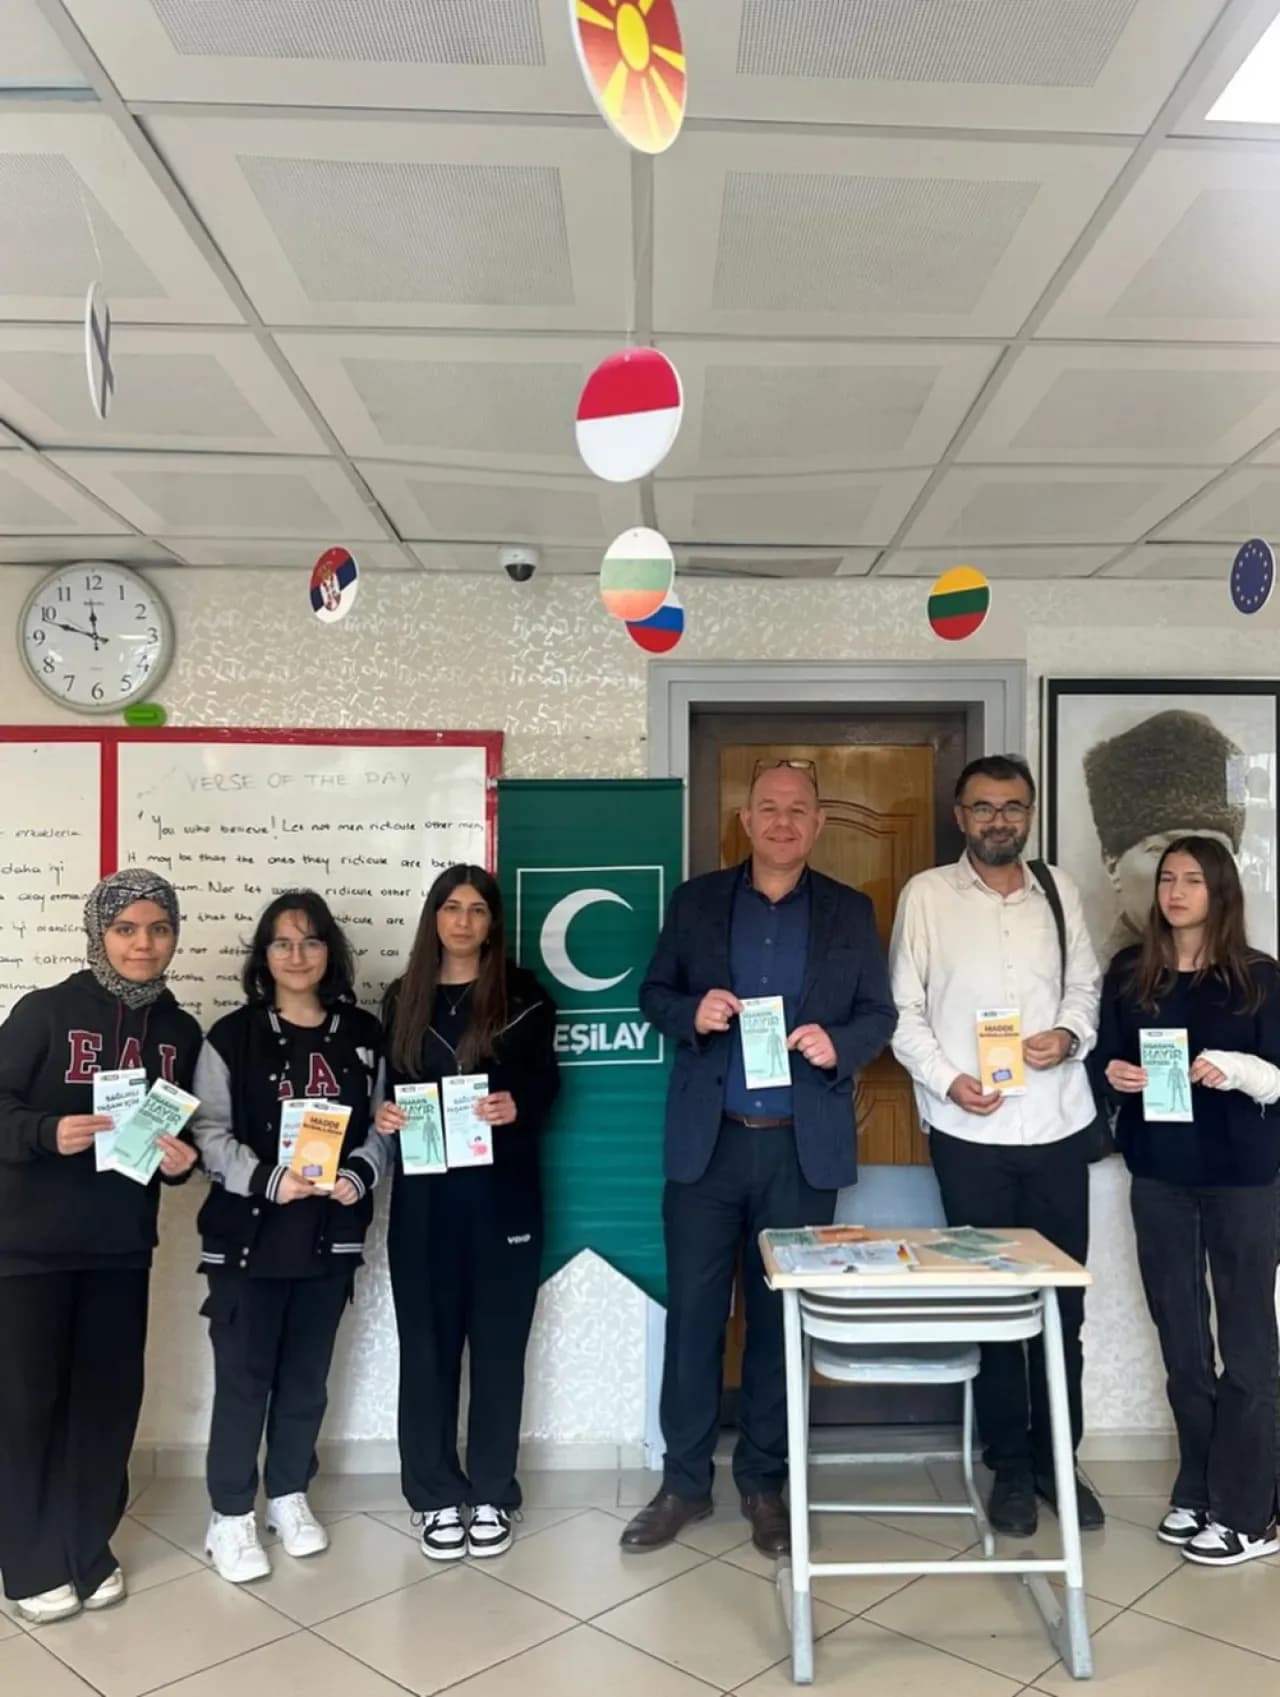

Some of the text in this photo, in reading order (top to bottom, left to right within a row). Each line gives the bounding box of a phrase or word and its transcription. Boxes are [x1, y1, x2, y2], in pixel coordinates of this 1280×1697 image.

[85, 575, 103, 591] 12
[57, 586, 71, 602] 11
[119, 585, 125, 600] 1
[41, 606, 57, 621] 10
[134, 603, 147, 620] 2
[32, 629, 46, 646] 9
[147, 627, 159, 644] 3
[42, 656, 56, 673] 8
[136, 654, 150, 672] 4
[63, 674, 76, 692] 7
[91, 682, 104, 700] 6
[120, 674, 132, 692] 5
[186, 771, 411, 792] VERSE OF THE DAY
[311, 822, 331, 832] not
[424, 820, 453, 830] other
[0, 863, 42, 875] daha
[147, 854, 172, 871] may
[178, 853, 193, 863] be
[198, 853, 227, 863] that
[236, 854, 255, 865] the
[267, 855, 297, 865] ones
[302, 854, 330, 876] they
[400, 858, 421, 868] are
[207, 880, 236, 894] Nor
[244, 883, 262, 893] let
[325, 885, 373, 897] ridicule
[380, 887, 411, 897] other
[333, 914, 375, 925] idicule
[386, 916, 405, 926] are
[552, 1021, 652, 1056] EŞİLAY
